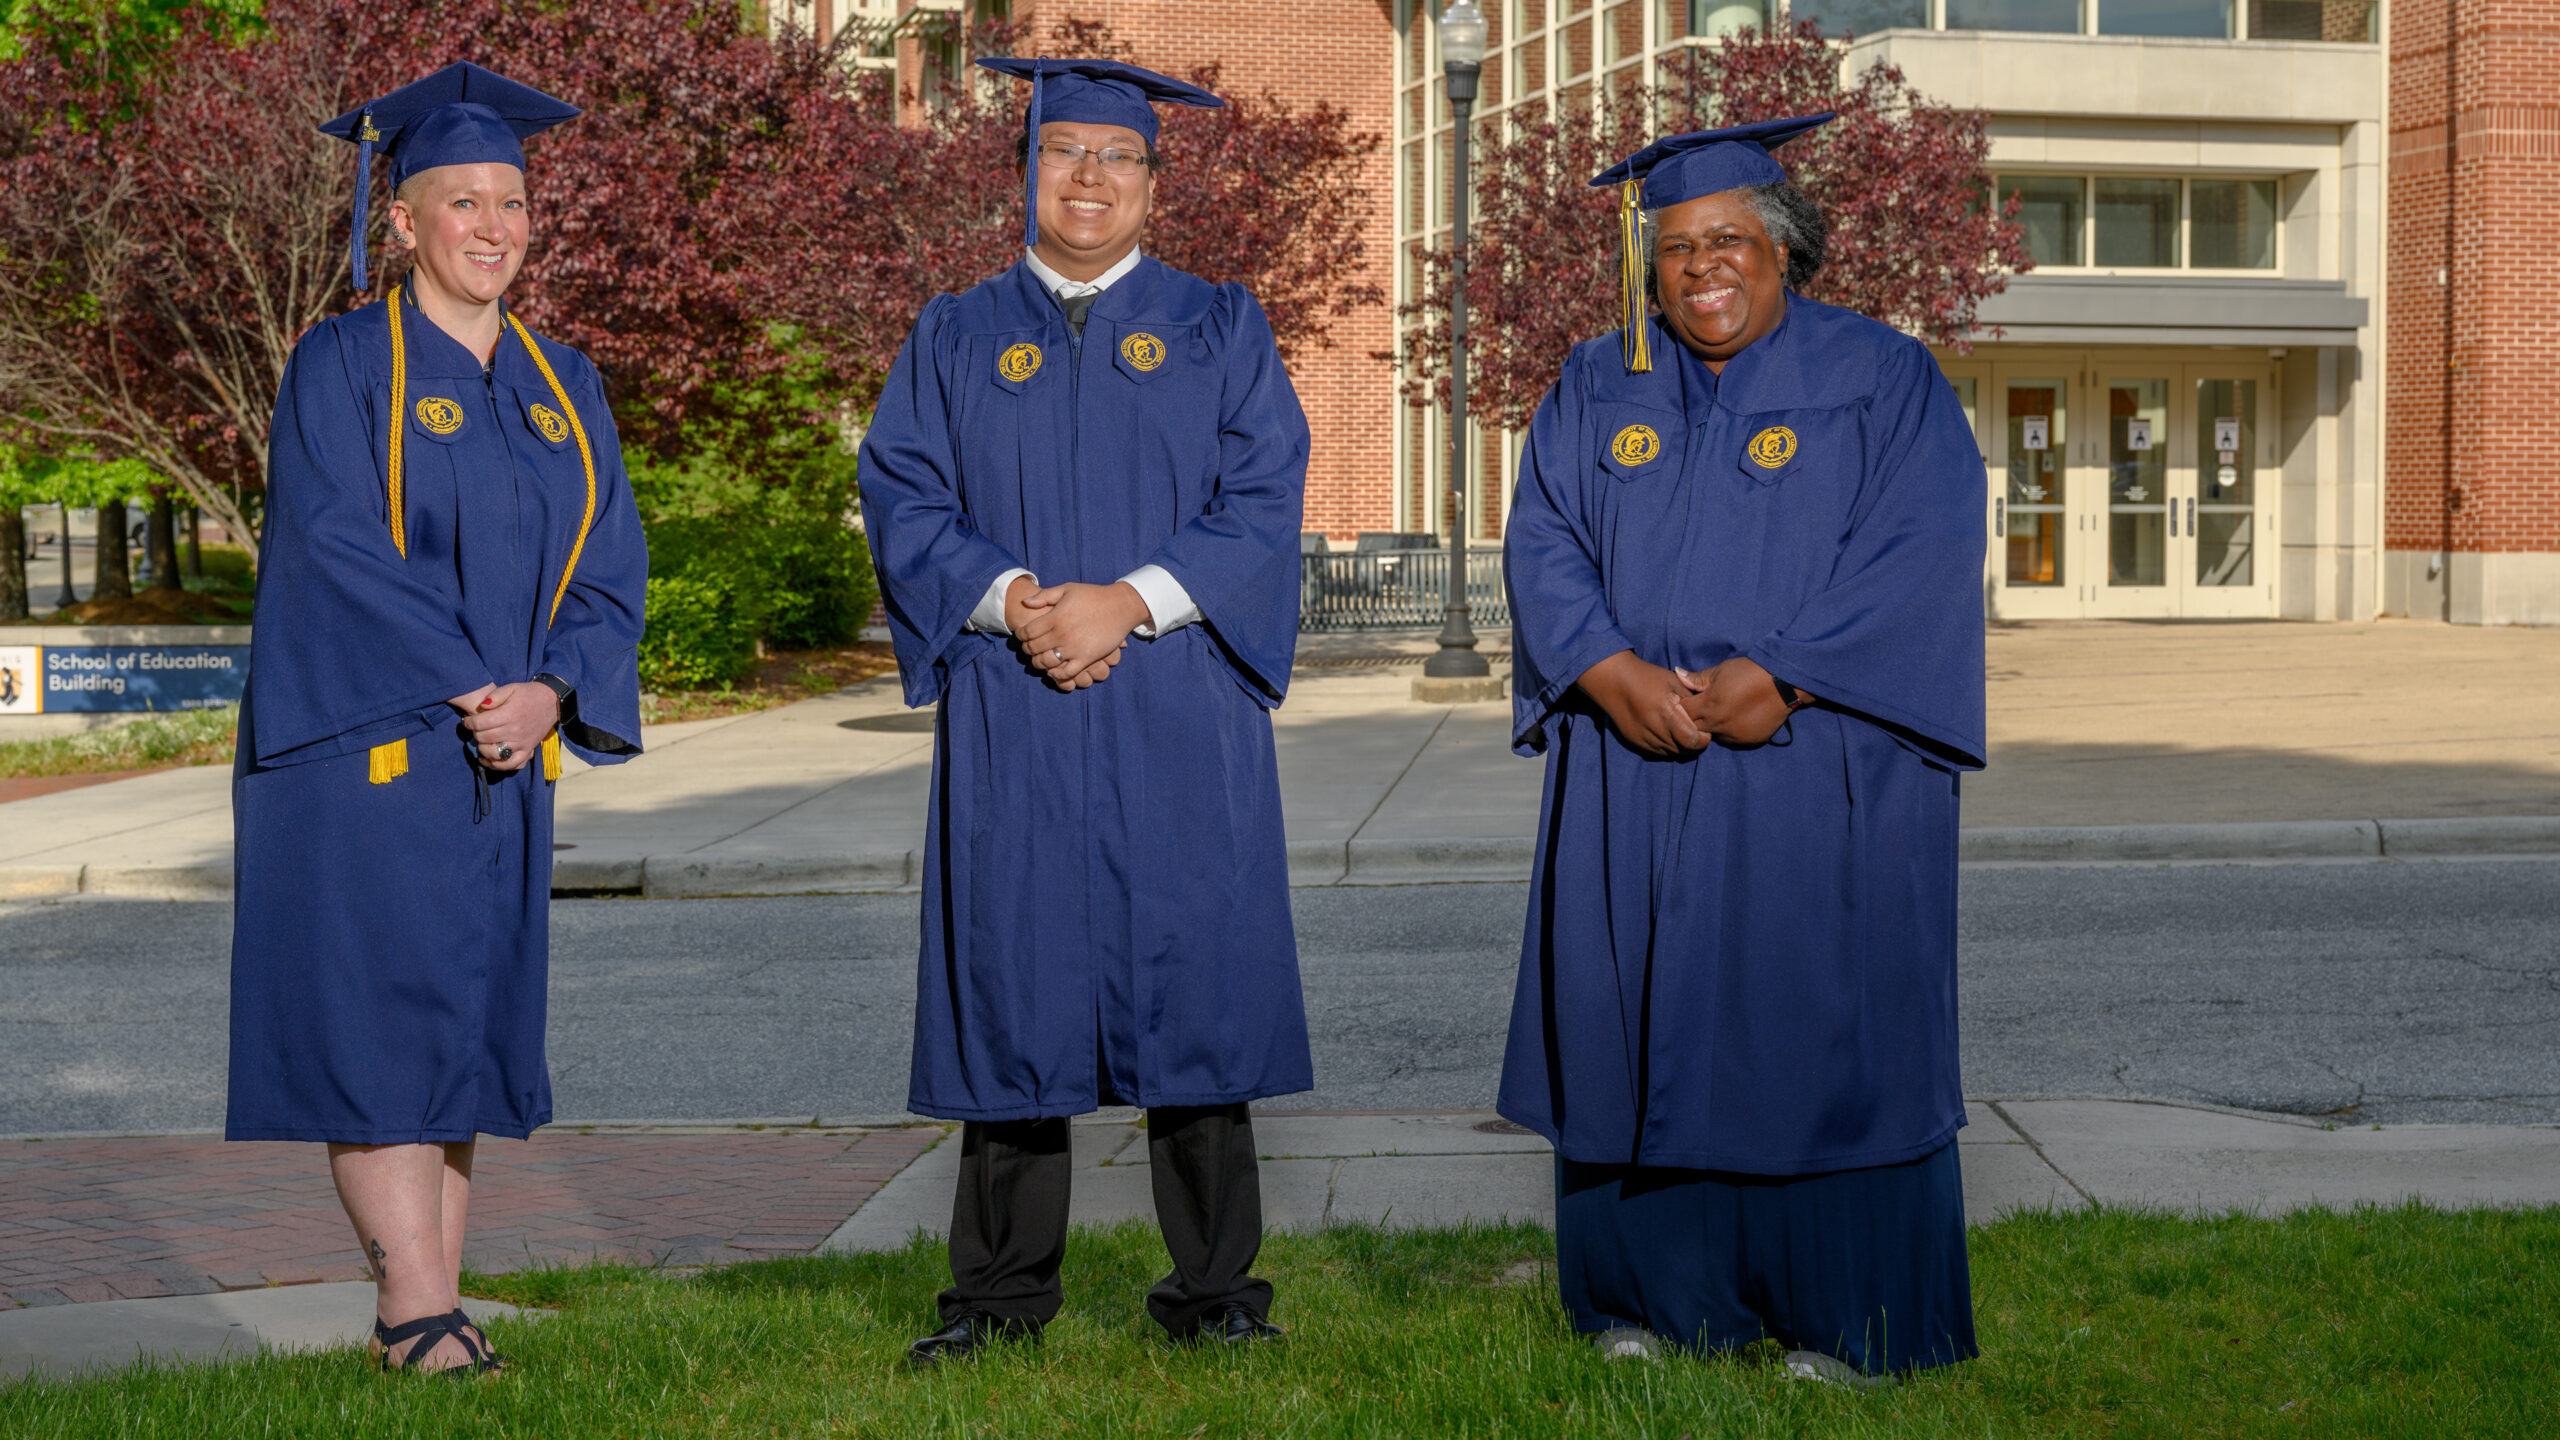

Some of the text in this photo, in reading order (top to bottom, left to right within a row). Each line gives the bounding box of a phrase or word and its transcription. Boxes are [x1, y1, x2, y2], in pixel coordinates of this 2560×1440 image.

[48, 652, 232, 671] School of Education
[49, 674, 126, 695] Building
